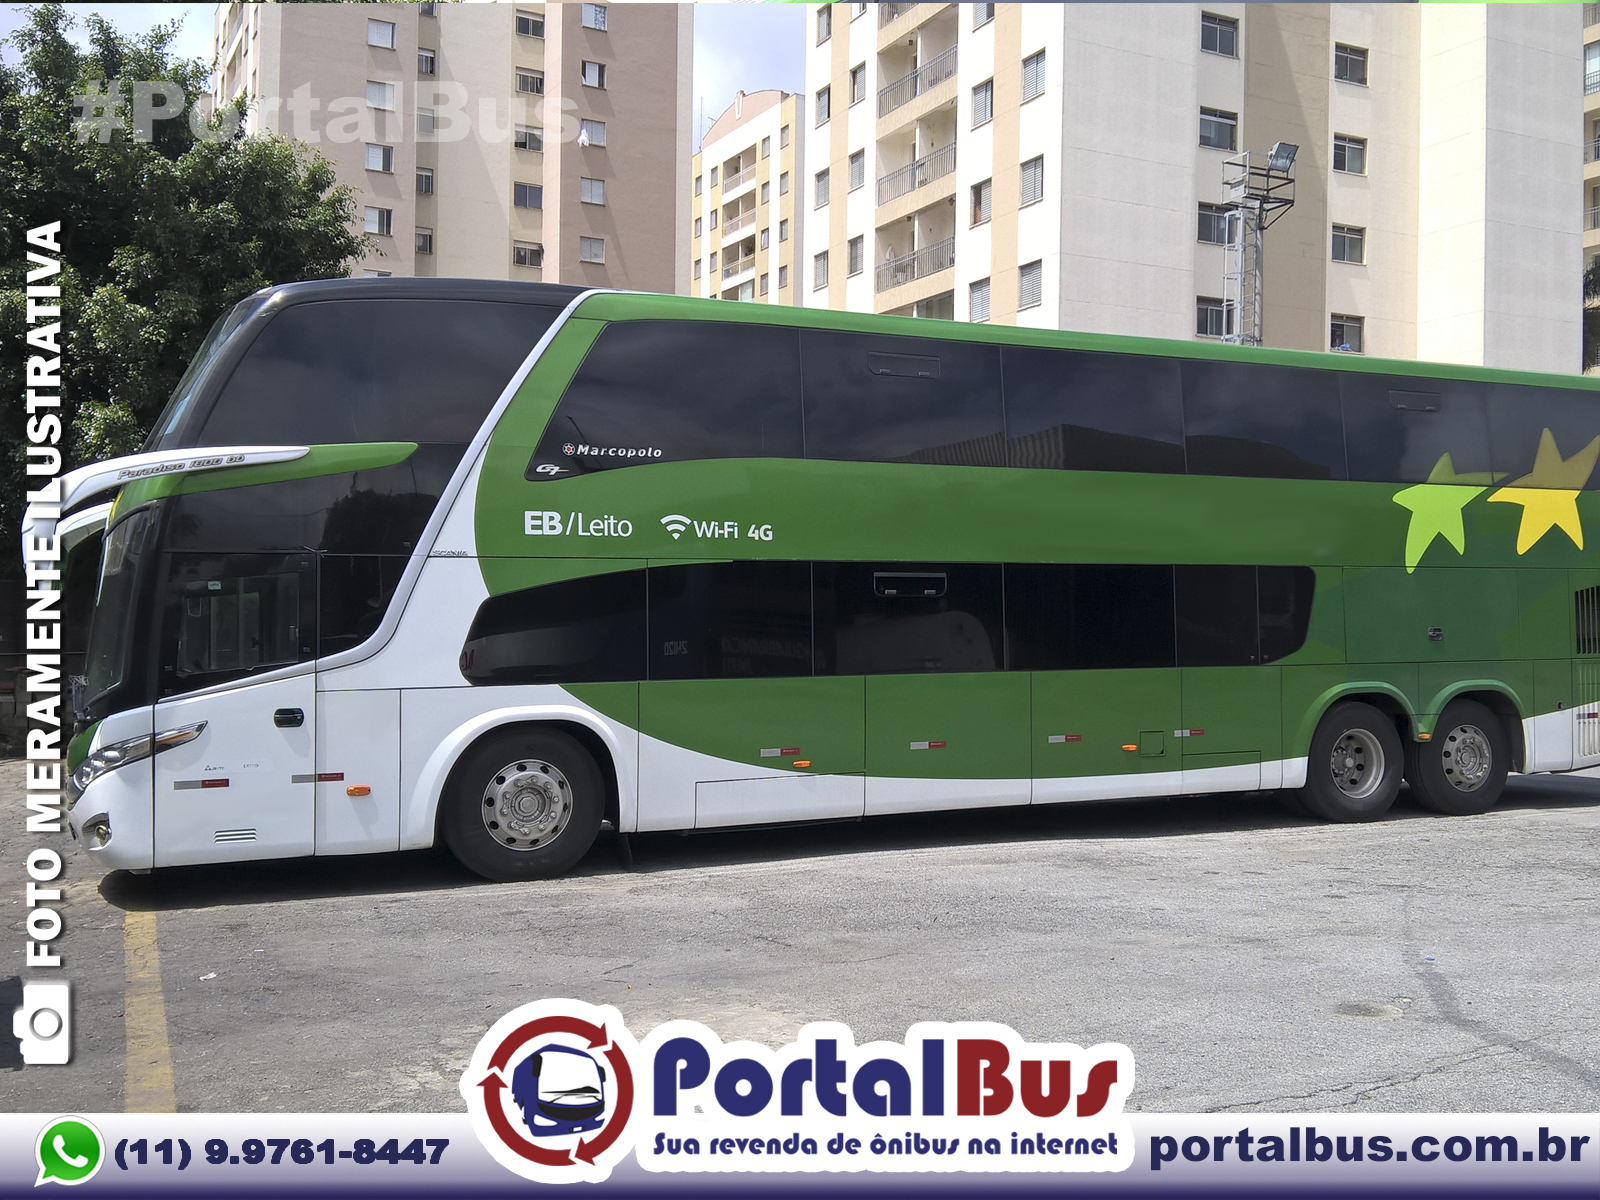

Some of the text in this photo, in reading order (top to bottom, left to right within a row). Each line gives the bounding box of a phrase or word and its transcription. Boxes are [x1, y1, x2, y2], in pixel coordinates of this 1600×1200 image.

[576, 444, 662, 458] Marcopolo
[117, 463, 185, 480] Paradiso
[693, 520, 773, 541] Wi-Fi 4G
